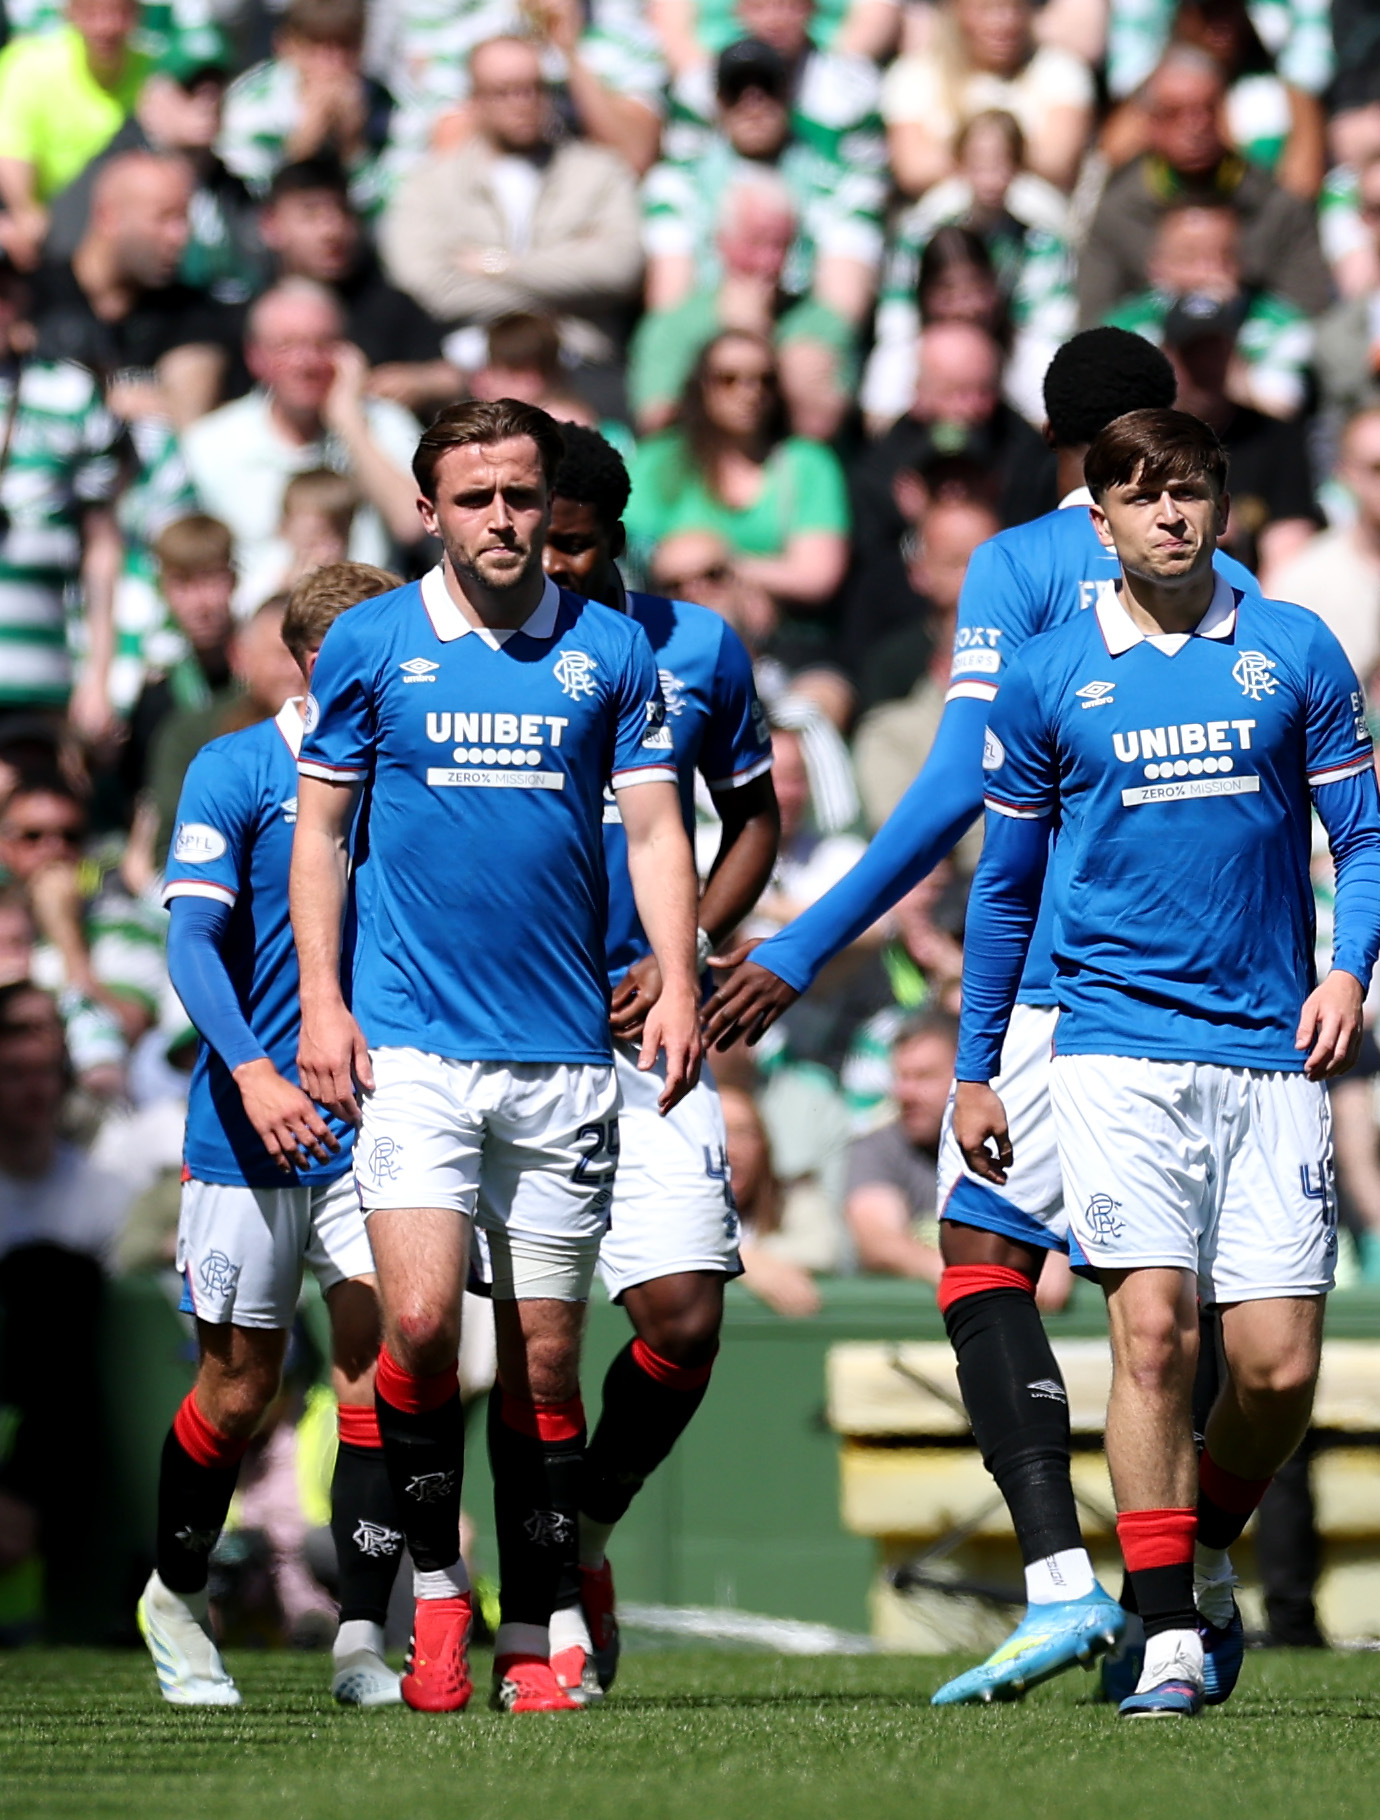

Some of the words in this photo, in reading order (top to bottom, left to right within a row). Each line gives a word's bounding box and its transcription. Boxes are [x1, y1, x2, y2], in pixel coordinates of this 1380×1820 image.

[955, 627, 1002, 648] OXT
[403, 675, 437, 684] umbro
[1081, 696, 1115, 710] umbro
[426, 712, 569, 747] UNIBET
[1112, 719, 1257, 763] UNIBET
[447, 772, 491, 783] ZERO%
[495, 773, 546, 785] MISSION
[1142, 785, 1186, 800] ZERO%
[1189, 779, 1243, 795] MISSION
